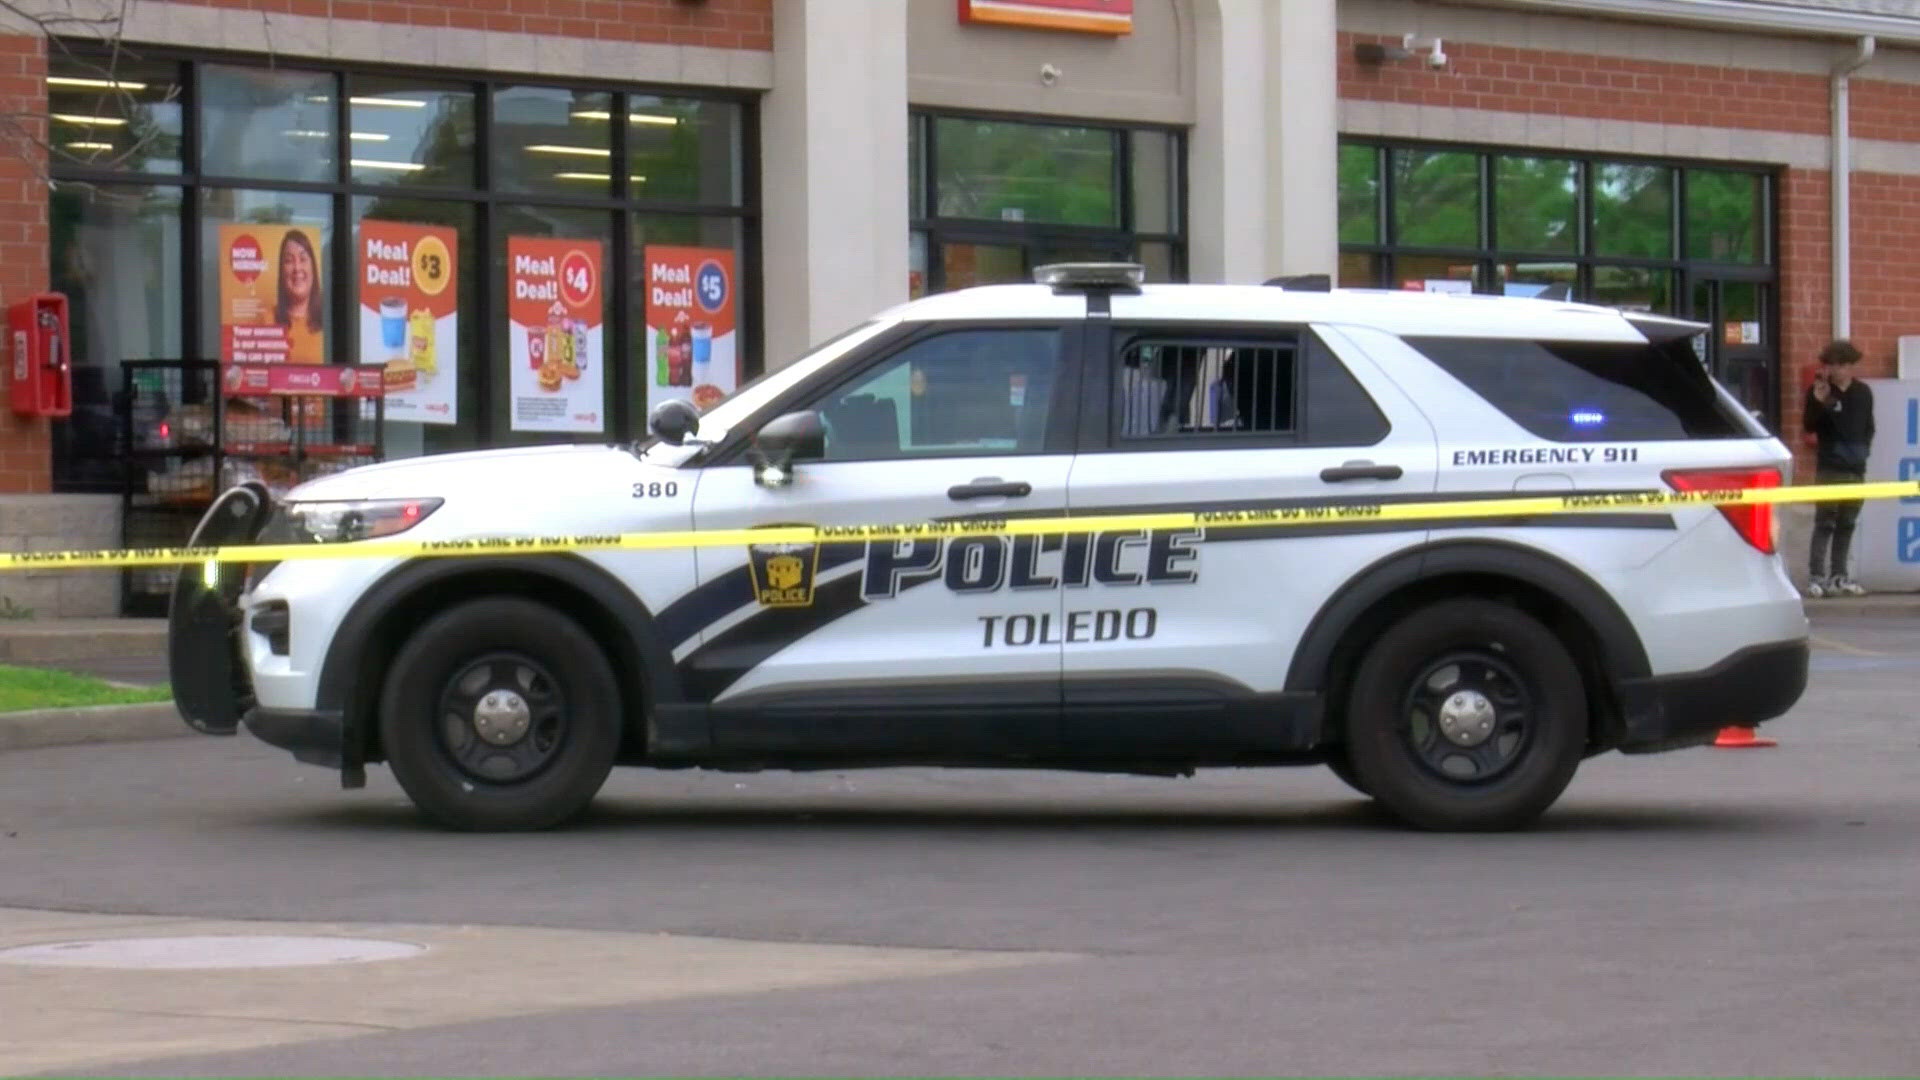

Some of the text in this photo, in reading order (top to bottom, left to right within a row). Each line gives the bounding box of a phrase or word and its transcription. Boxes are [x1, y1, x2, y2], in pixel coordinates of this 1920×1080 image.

[232, 247, 257, 259] NOW
[366, 239, 408, 260] Meal
[366, 264, 410, 287] Deal!
[421, 254, 441, 279] $3
[515, 255, 555, 275] Meal
[652, 263, 690, 284] Meal
[515, 279, 558, 300] Deal!
[566, 266, 588, 293] $4
[702, 274, 722, 301] $5
[652, 287, 692, 308] Deal!
[1453, 447, 1638, 466] EMERGENCY 911
[632, 481, 678, 499] 380
[860, 526, 1206, 600] POLICE
[761, 588, 806, 602] POLICE
[978, 607, 1157, 648] TOLEDO
